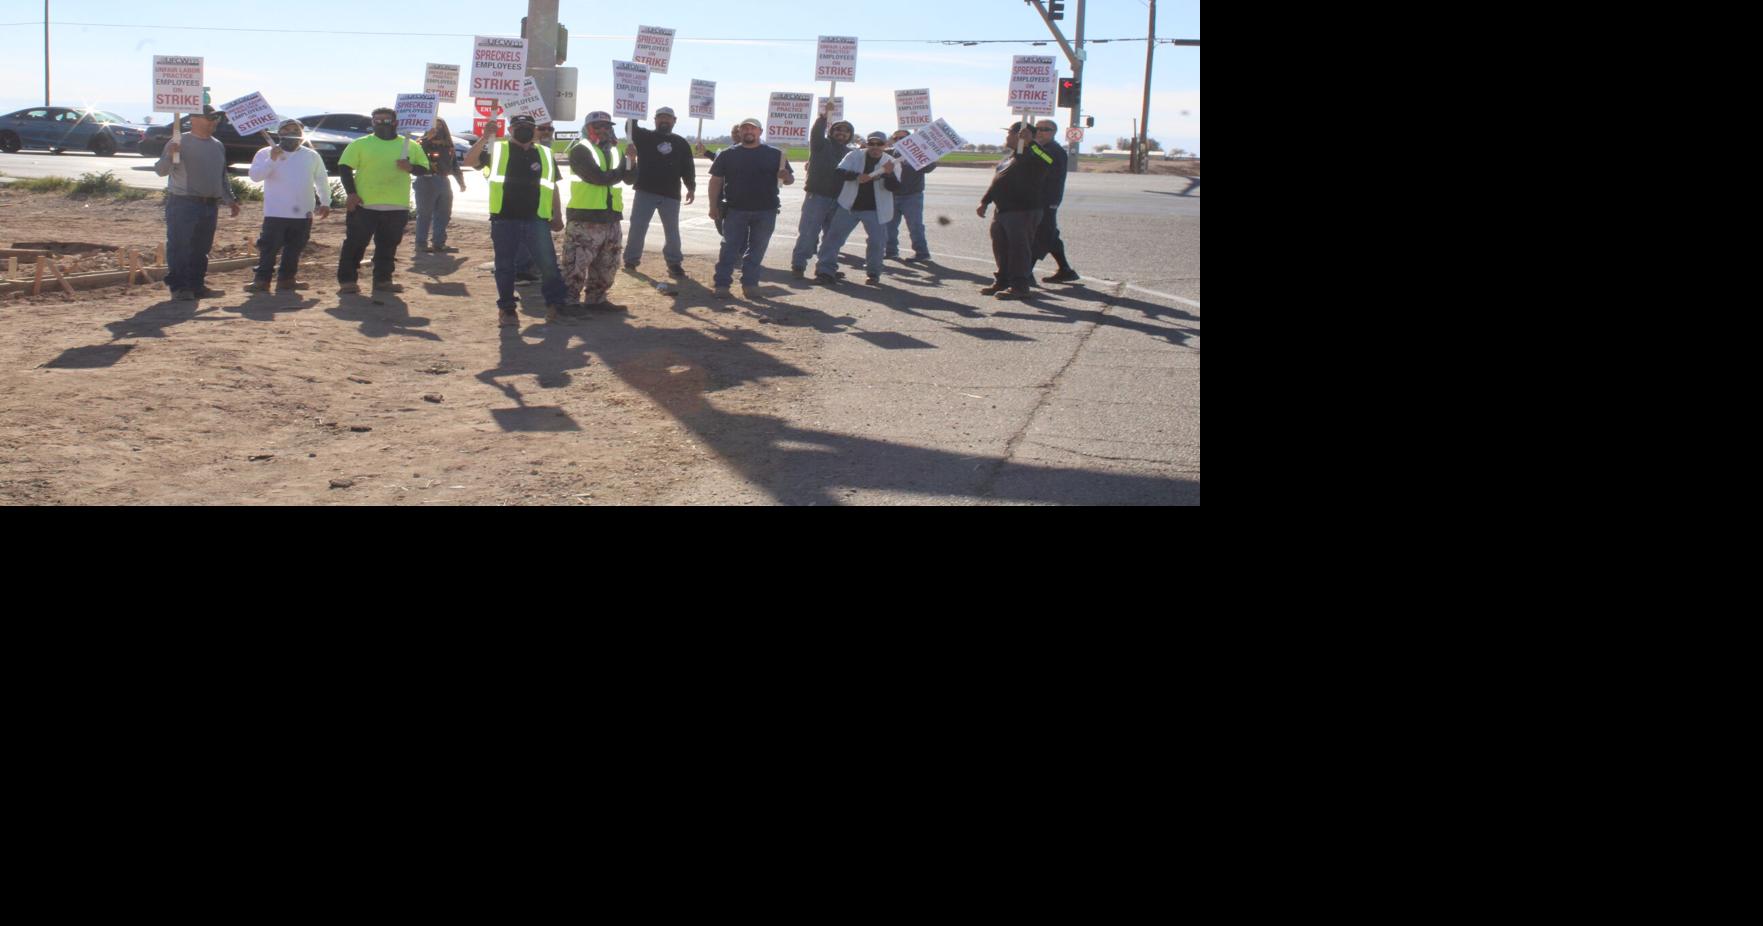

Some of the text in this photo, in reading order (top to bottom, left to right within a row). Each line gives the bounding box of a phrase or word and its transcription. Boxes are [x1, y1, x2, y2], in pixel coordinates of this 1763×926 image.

[475, 49, 521, 62] SPRECKELS
[475, 61, 522, 70] EMPLOYEES
[634, 56, 667, 68] STRIKE
[818, 66, 853, 76] STRIKE
[1012, 65, 1050, 76] SPRECKELS
[156, 79, 200, 87] EMPLOYEES
[473, 77, 520, 91] STRIKE
[616, 83, 647, 93] EMPLOYEES
[156, 94, 200, 106] STRIKE
[1010, 90, 1048, 101] STRIKE
[504, 96, 540, 109] EMPLOYEES
[616, 99, 646, 113] STRIKE
[238, 113, 276, 132] STRIKE
[900, 115, 929, 125] STRIKE
[769, 126, 807, 137] STRIKE
[902, 139, 929, 165] STRIKE
